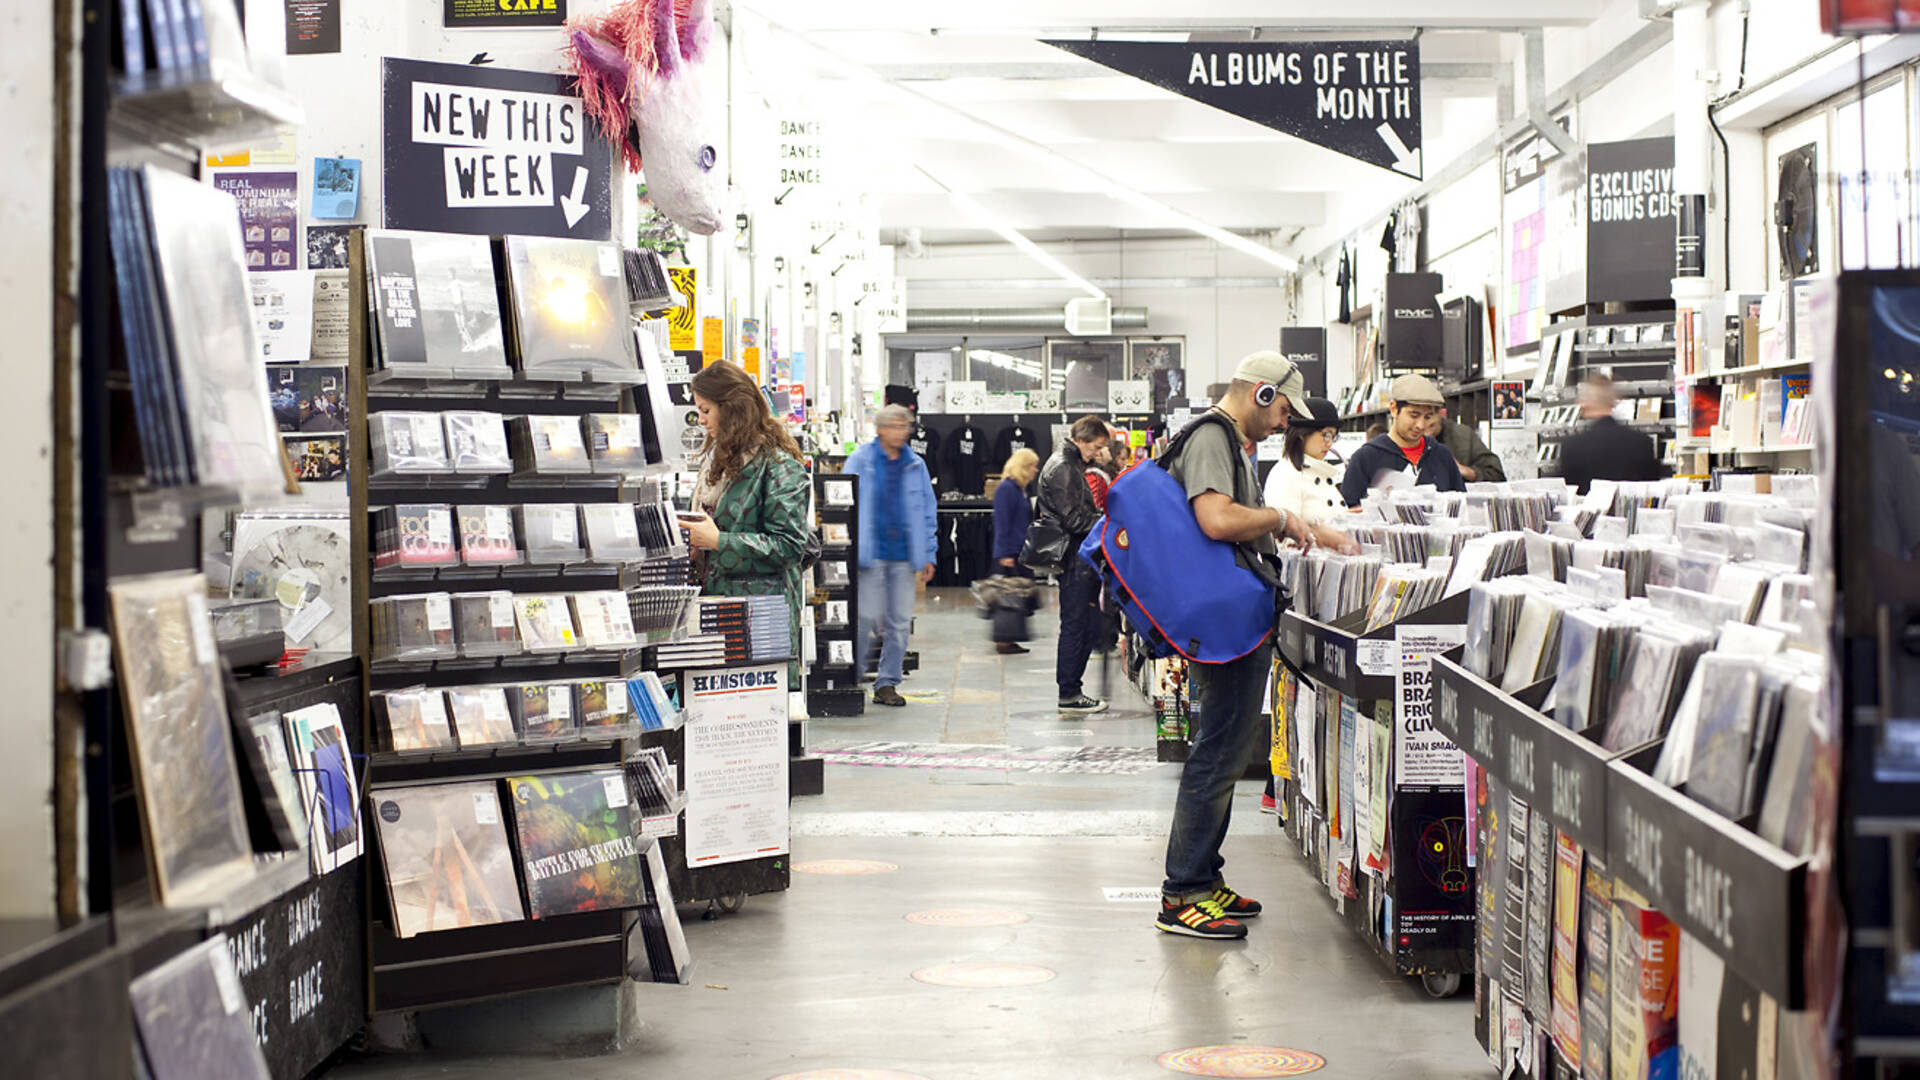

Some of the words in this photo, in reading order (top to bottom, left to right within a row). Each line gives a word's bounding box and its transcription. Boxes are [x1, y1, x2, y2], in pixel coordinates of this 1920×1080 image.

[1188, 52, 1302, 86] ALBUMS
[1313, 52, 1348, 85] OF
[1355, 51, 1410, 84] THE
[423, 91, 490, 140] NEW
[502, 98, 574, 144] THIS
[1316, 86, 1411, 120] MONTH
[780, 120, 821, 135] DANCE
[780, 144, 821, 158] DANCE
[220, 178, 252, 189] REAL
[454, 154, 544, 199] WEEK
[780, 168, 821, 183] DANCE
[1590, 168, 1676, 198] EXCLUSIV
[229, 187, 291, 198] UMINIUM
[1591, 193, 1645, 223] BONUS
[1394, 308, 1434, 319] PMC
[692, 670, 778, 691] HEMSTOCK
[1405, 742, 1428, 750] IVAN
[526, 852, 572, 881] BATTLE
[567, 847, 595, 872] FOR
[589, 835, 638, 865] SEATTLE
[1685, 846, 1734, 949] DANCE
[288, 886, 322, 947] DANCE
[290, 959, 323, 1024] DANCE
